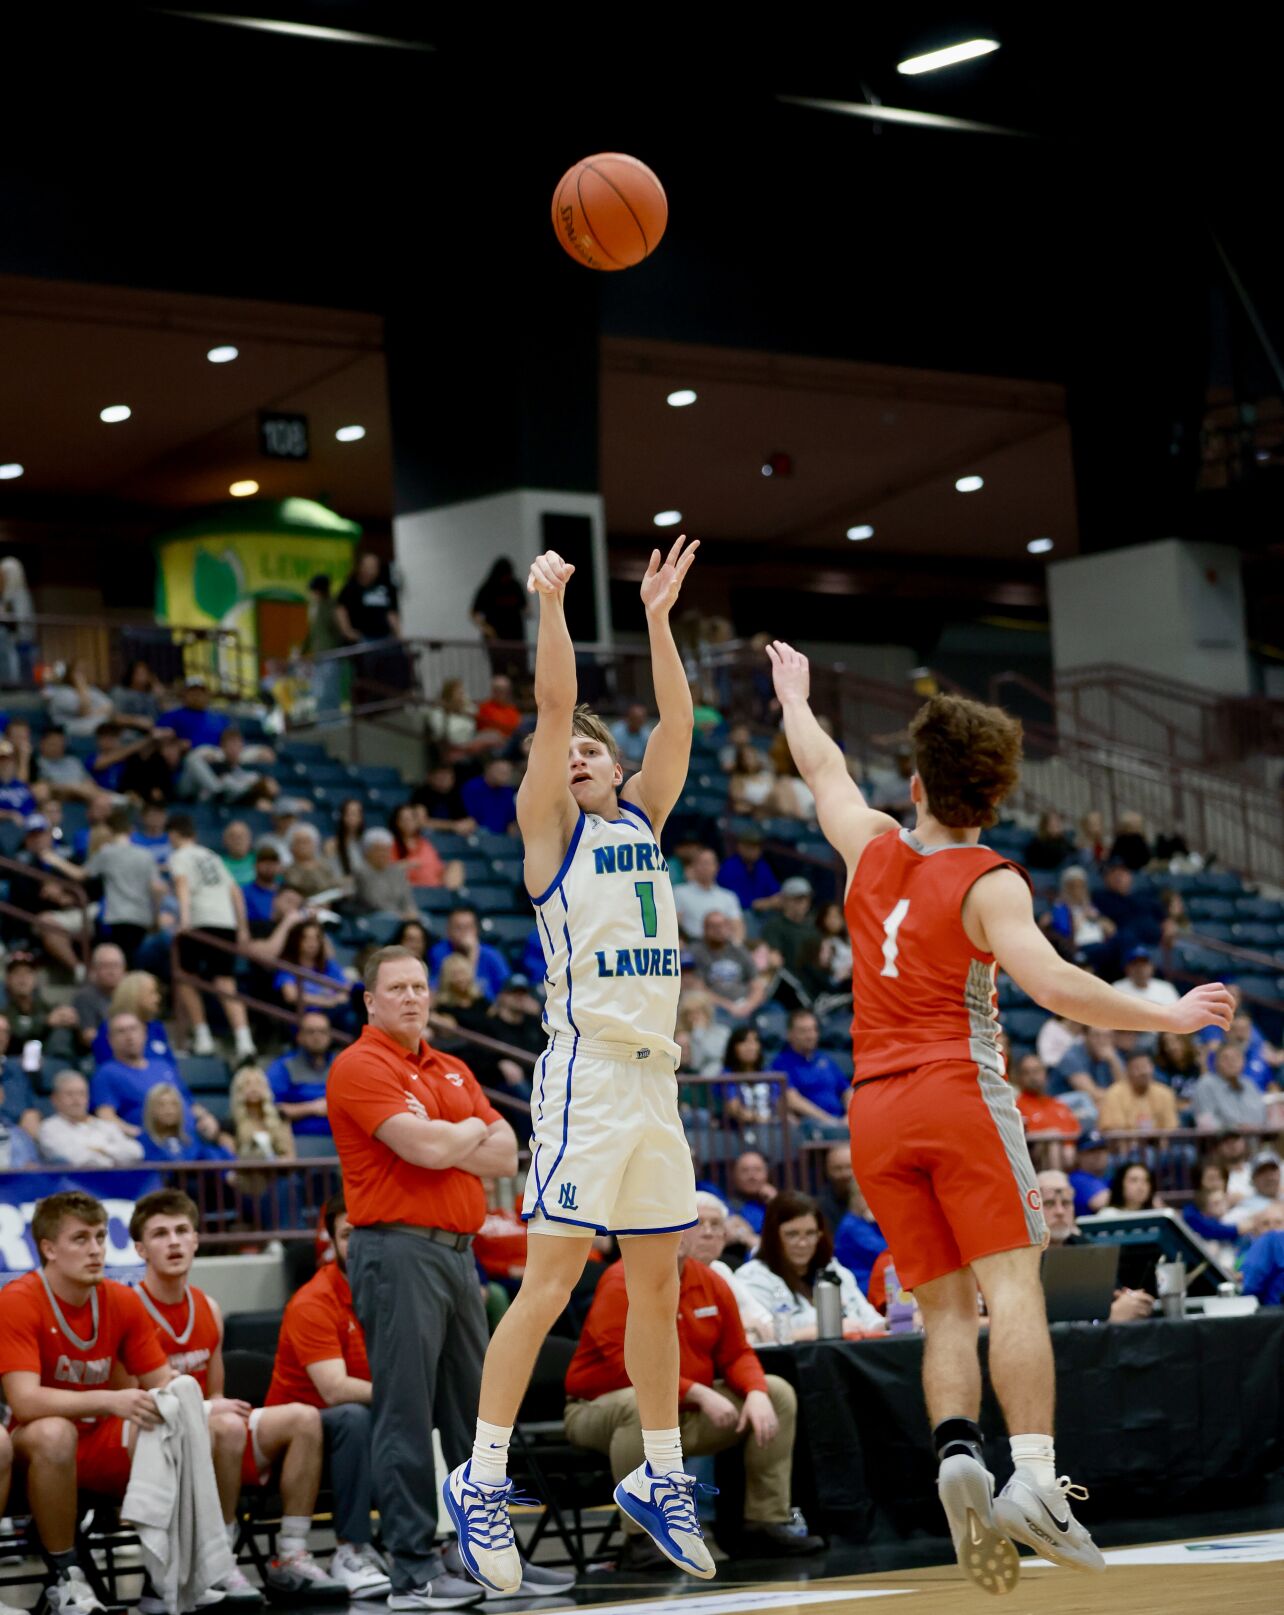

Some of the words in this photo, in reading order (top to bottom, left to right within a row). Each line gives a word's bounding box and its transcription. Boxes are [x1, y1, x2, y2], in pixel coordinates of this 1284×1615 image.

[634, 881, 657, 938] 1
[880, 898, 911, 978] 1
[1026, 1188, 1041, 1211] C
